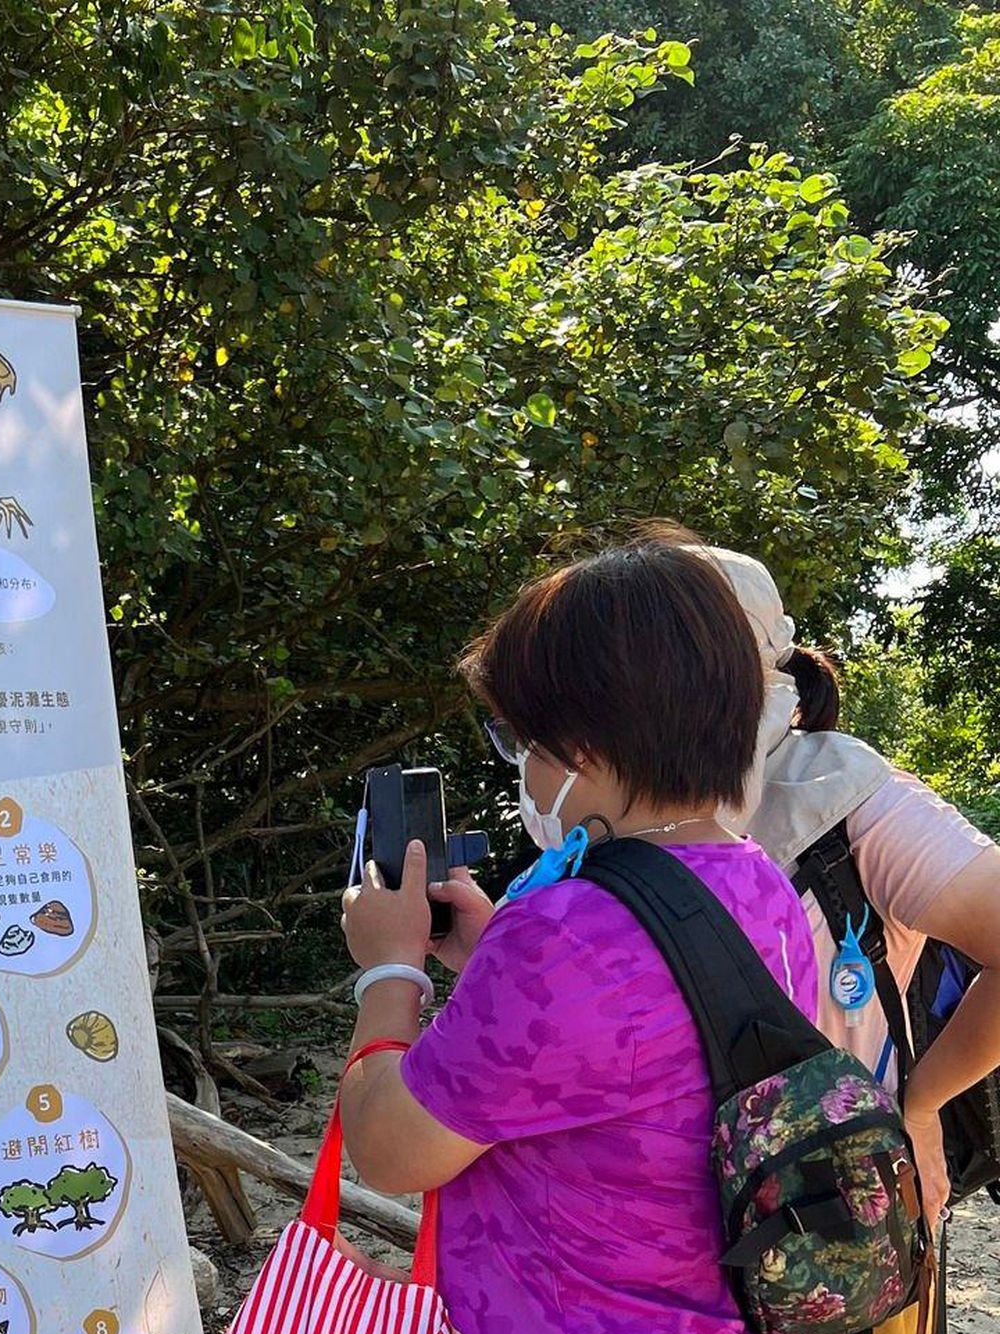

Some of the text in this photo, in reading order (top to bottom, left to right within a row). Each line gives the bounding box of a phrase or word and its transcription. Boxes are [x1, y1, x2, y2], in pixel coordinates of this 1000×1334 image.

[0, 810, 12, 828] 2
[38, 1093, 51, 1111] 5
[1, 1128, 100, 1161] 避開紅樹
